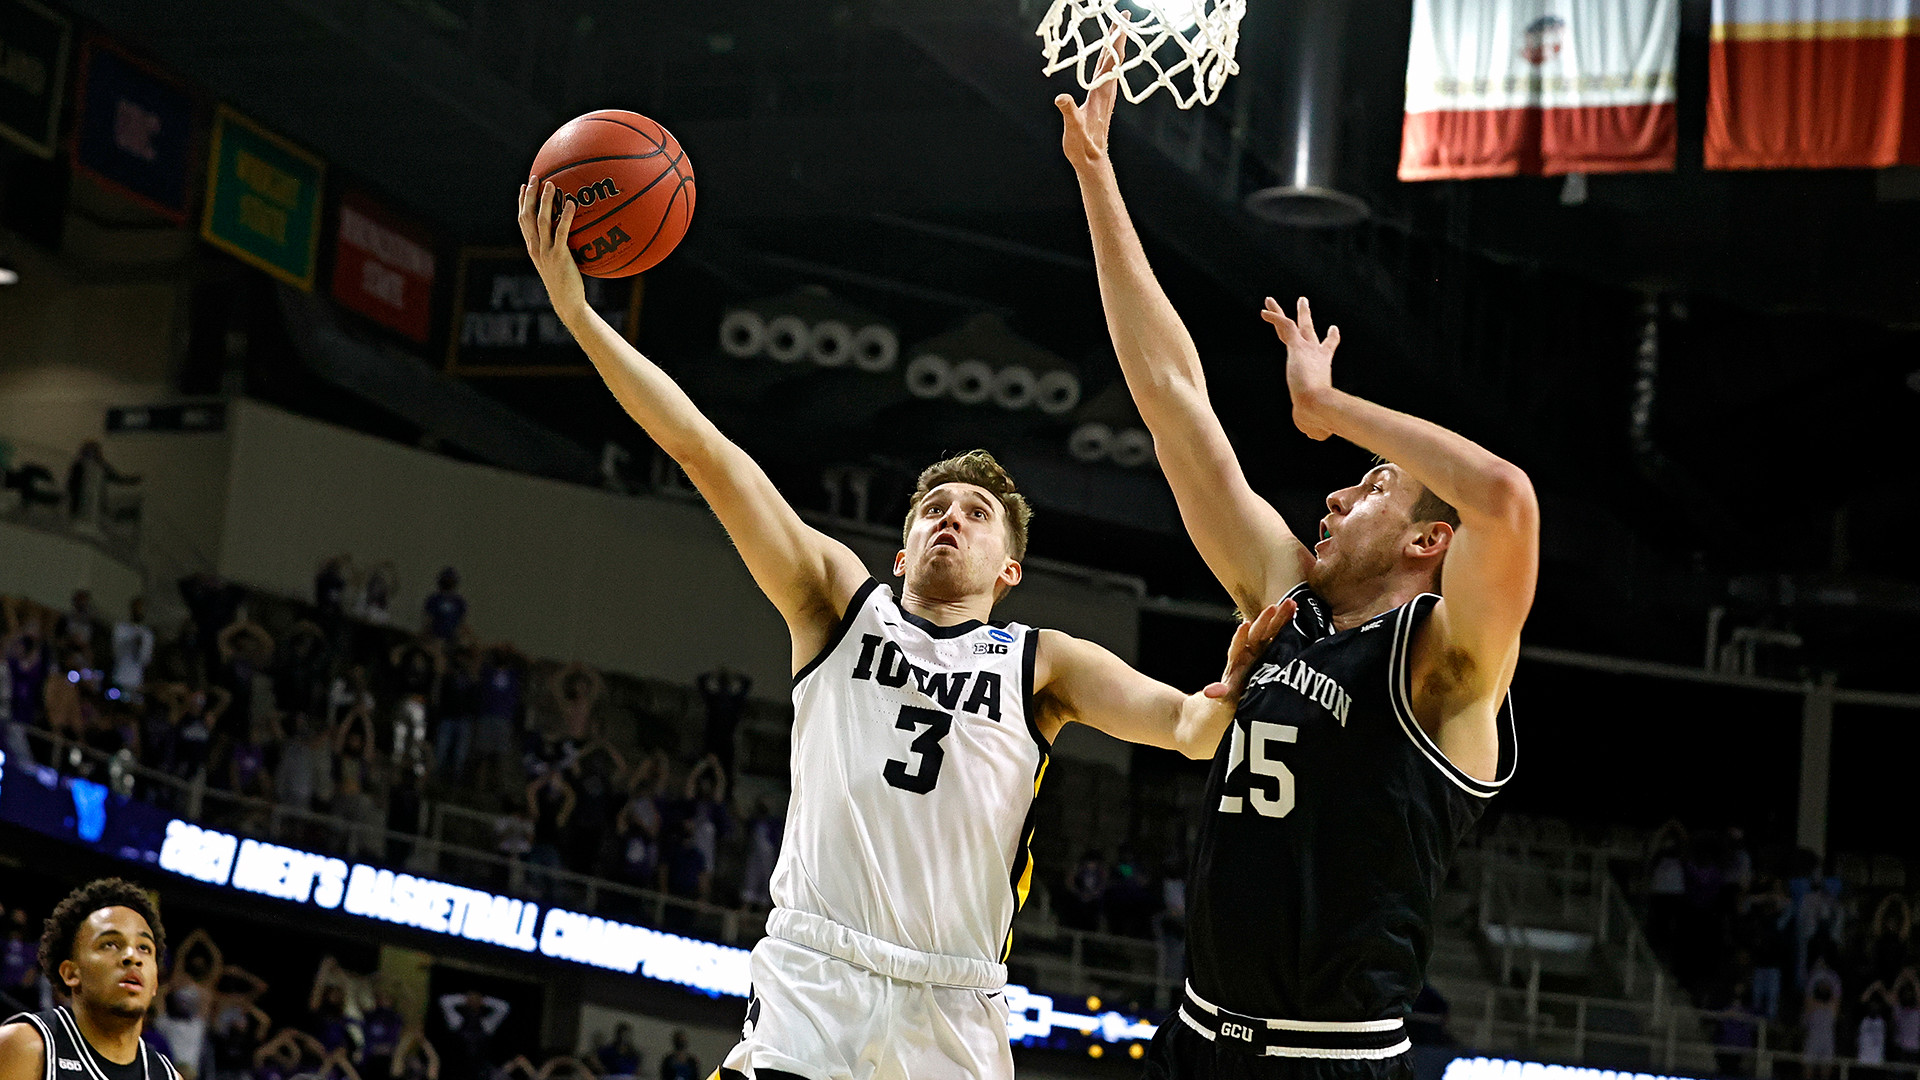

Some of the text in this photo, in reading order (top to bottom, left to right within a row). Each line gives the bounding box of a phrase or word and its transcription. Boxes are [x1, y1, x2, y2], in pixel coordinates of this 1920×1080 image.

[851, 633, 1002, 722] IOWA
[882, 704, 954, 795] 3
[159, 818, 238, 886] 2021
[231, 838, 349, 910] MEN'S
[344, 863, 539, 953] BASKETBALL
[1221, 1021, 1254, 1043] GCU
